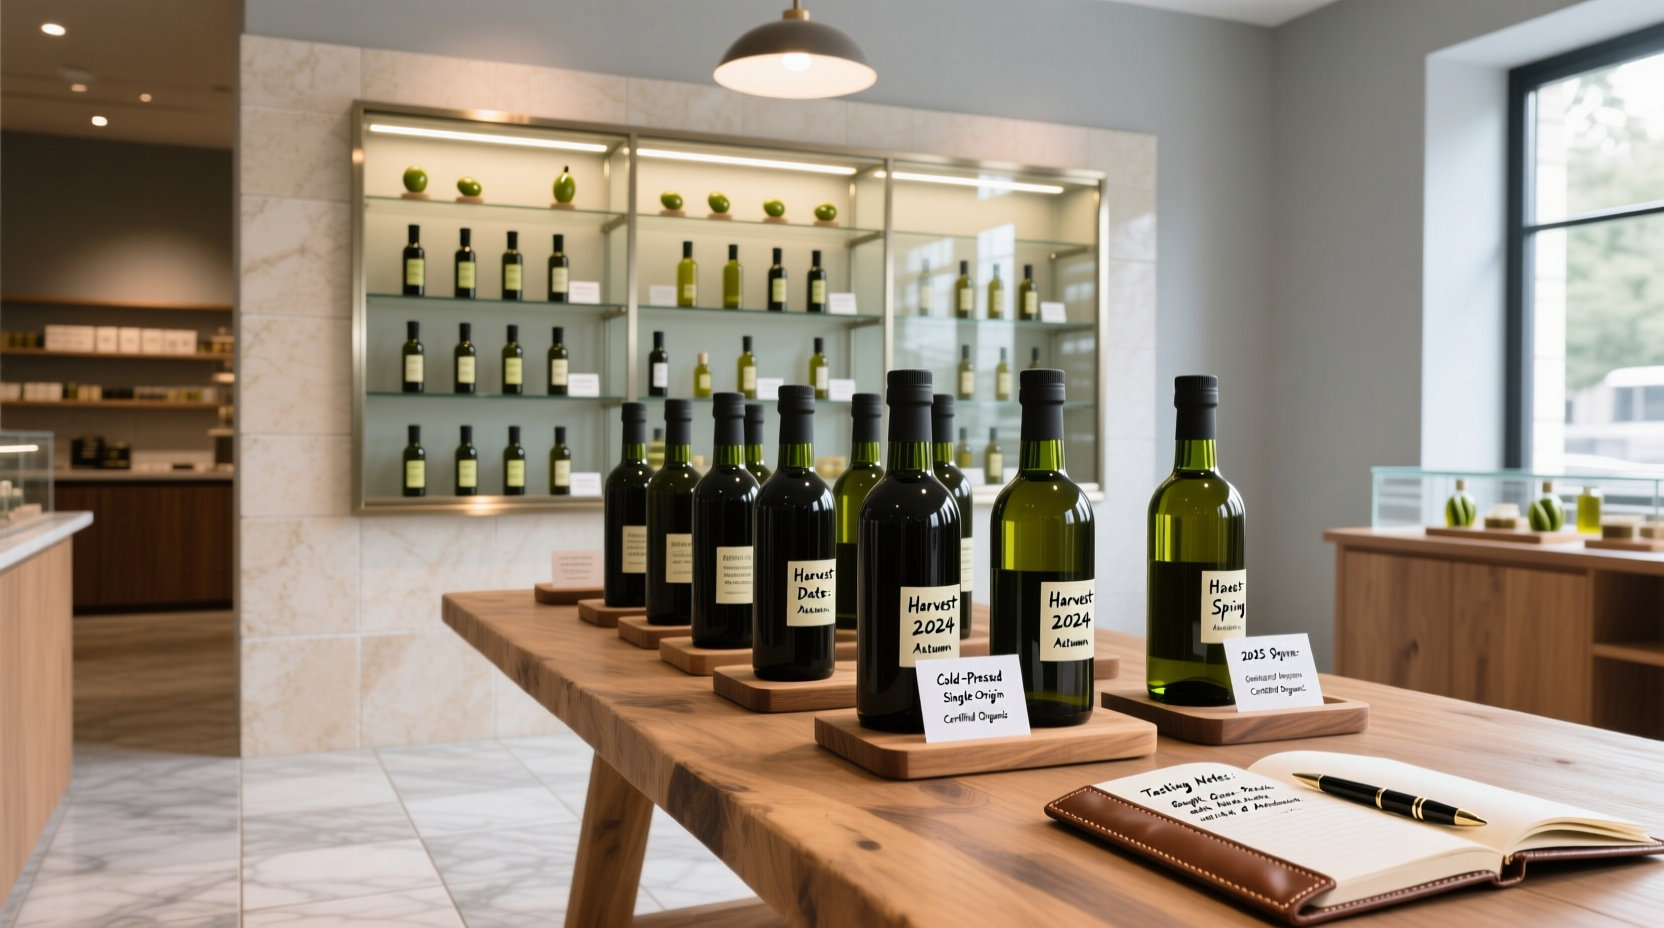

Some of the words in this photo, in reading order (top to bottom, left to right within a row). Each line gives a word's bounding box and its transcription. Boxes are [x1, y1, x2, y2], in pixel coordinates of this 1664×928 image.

[794, 567, 835, 583] Harvest
[908, 595, 958, 614] Harvest
[1049, 590, 1094, 609] Harvest
[912, 616, 955, 636] 2024
[1051, 611, 1091, 630] 2024
[1241, 648, 1266, 661] 2025
[936, 669, 1003, 686] Cold-Pressed
[943, 690, 973, 706] Single
[974, 688, 1005, 704] Origin
[1140, 781, 1193, 798] Tasting
